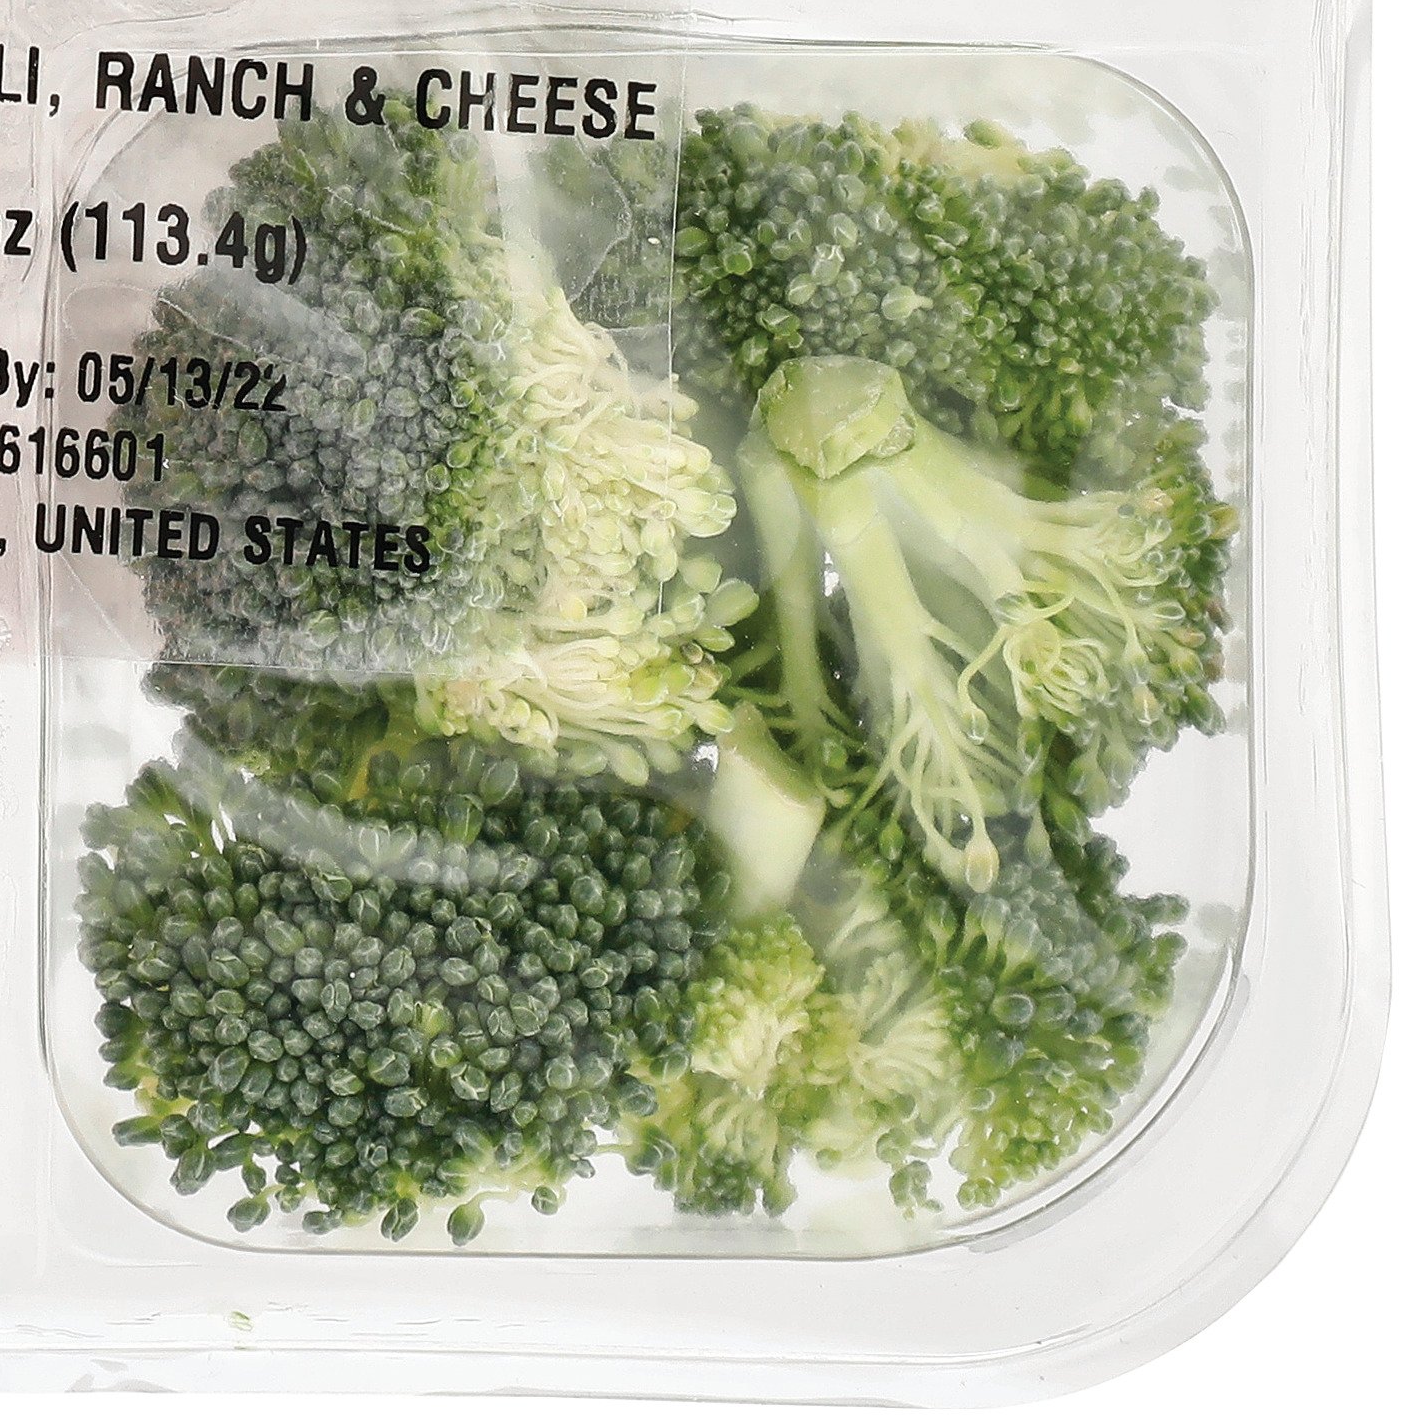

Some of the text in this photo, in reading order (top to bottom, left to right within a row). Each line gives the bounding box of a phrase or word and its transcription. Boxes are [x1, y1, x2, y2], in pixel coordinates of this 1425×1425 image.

[96, 52, 313, 122] RANCH
[344, 66, 386, 126] &
[416, 69, 657, 140] CHEESE
[60, 200, 308, 285] (113.4g)
[77, 351, 286, 412] 05/13/22
[35, 503, 220, 561] UNITED
[243, 515, 431, 574] STATES
